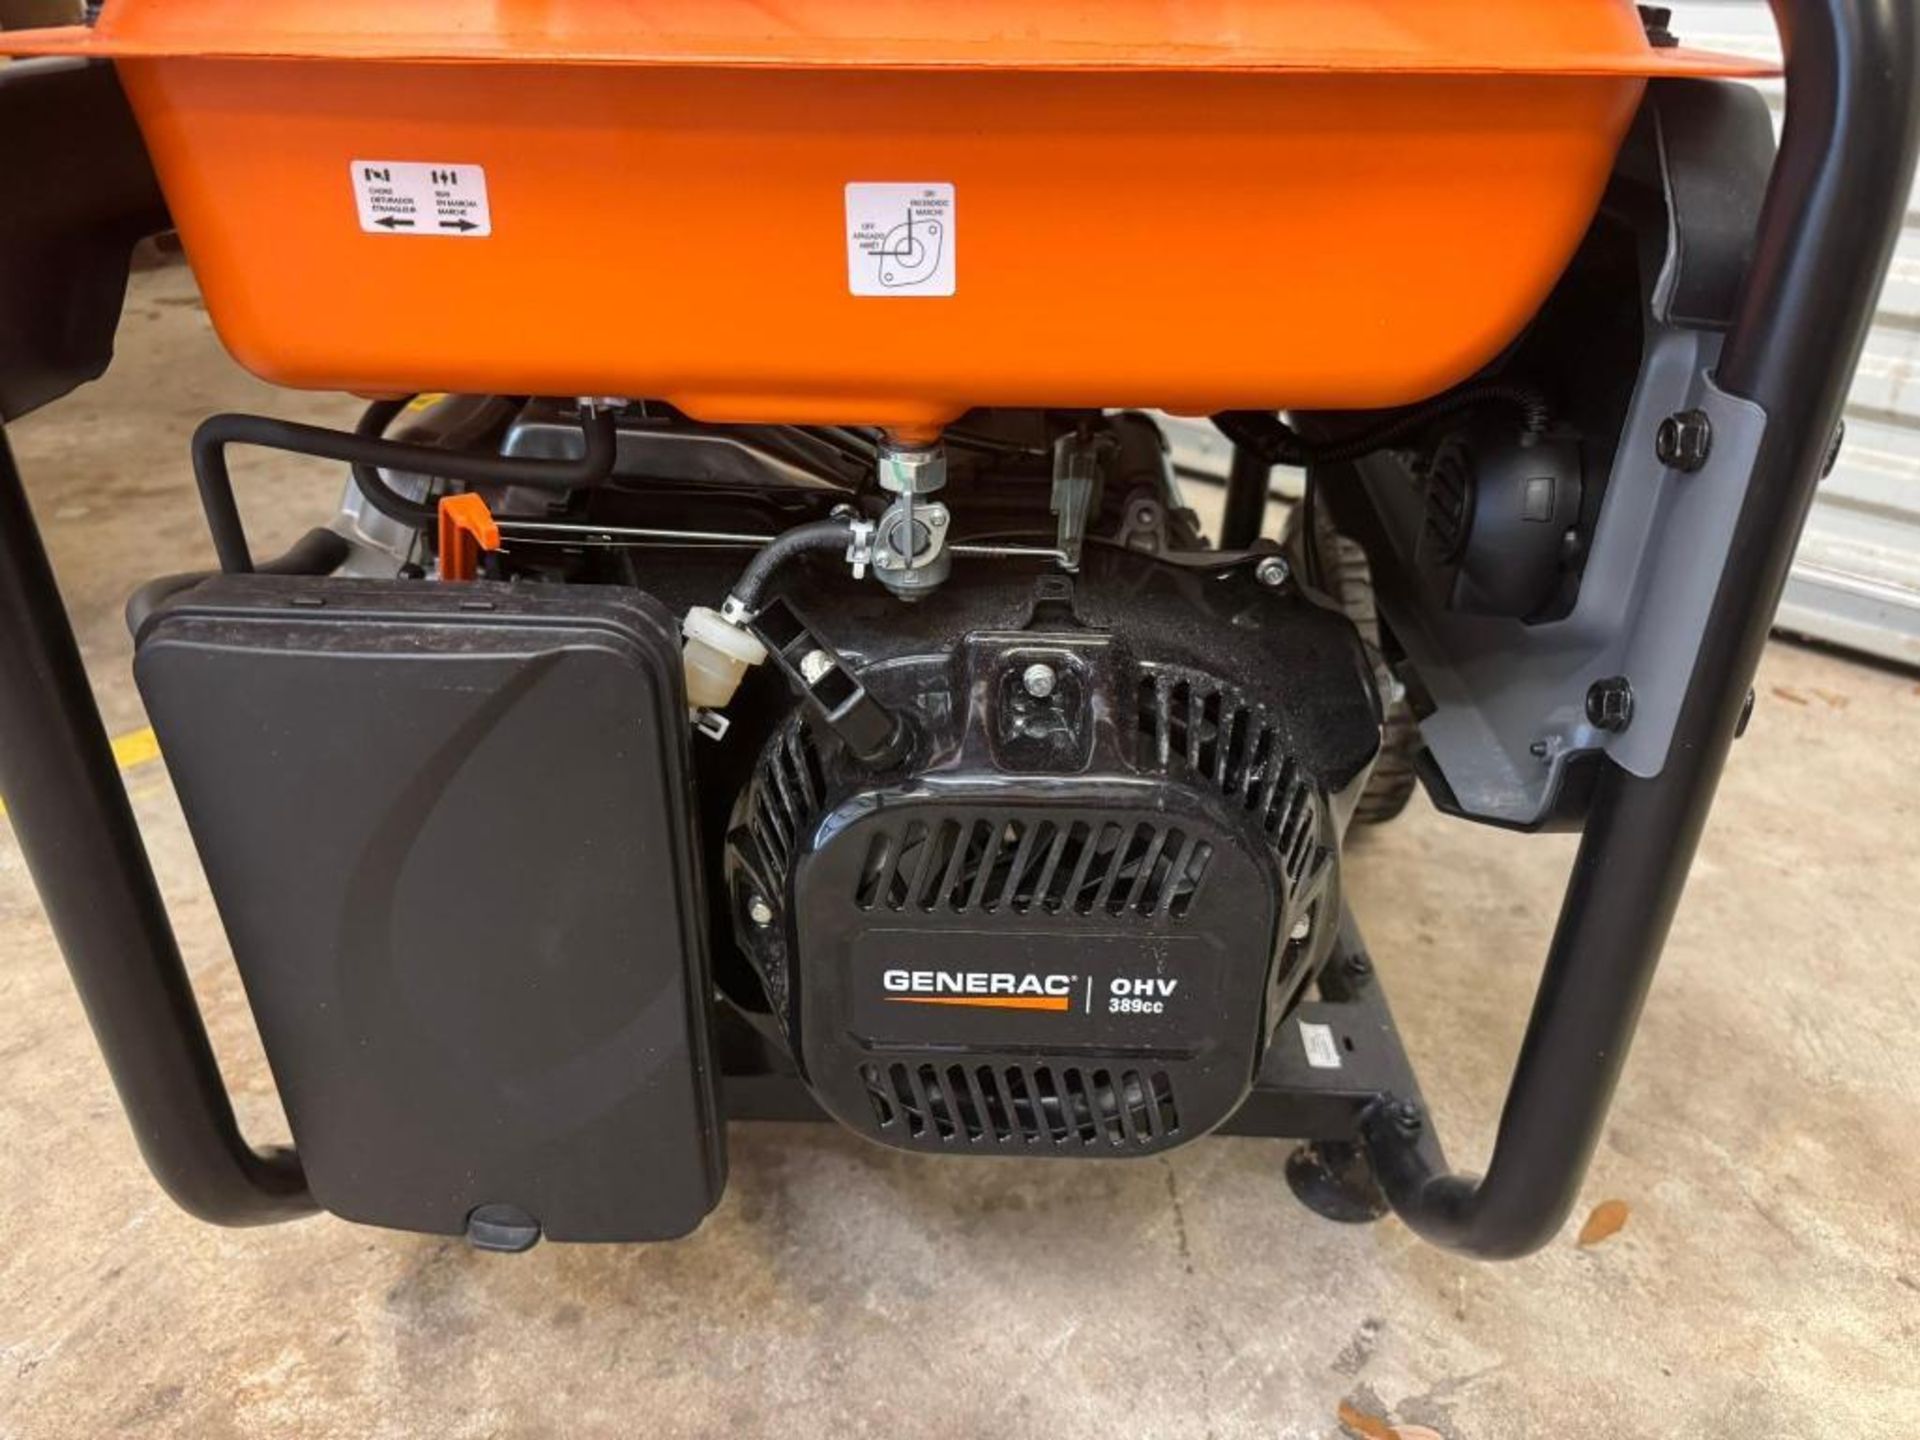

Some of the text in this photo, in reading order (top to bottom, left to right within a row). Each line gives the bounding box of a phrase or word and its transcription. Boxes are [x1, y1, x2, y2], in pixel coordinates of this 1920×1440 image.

[883, 969, 1071, 995] GENERAC
[1110, 978, 1178, 996] OHV
[1108, 998, 1164, 1014] 389cc
